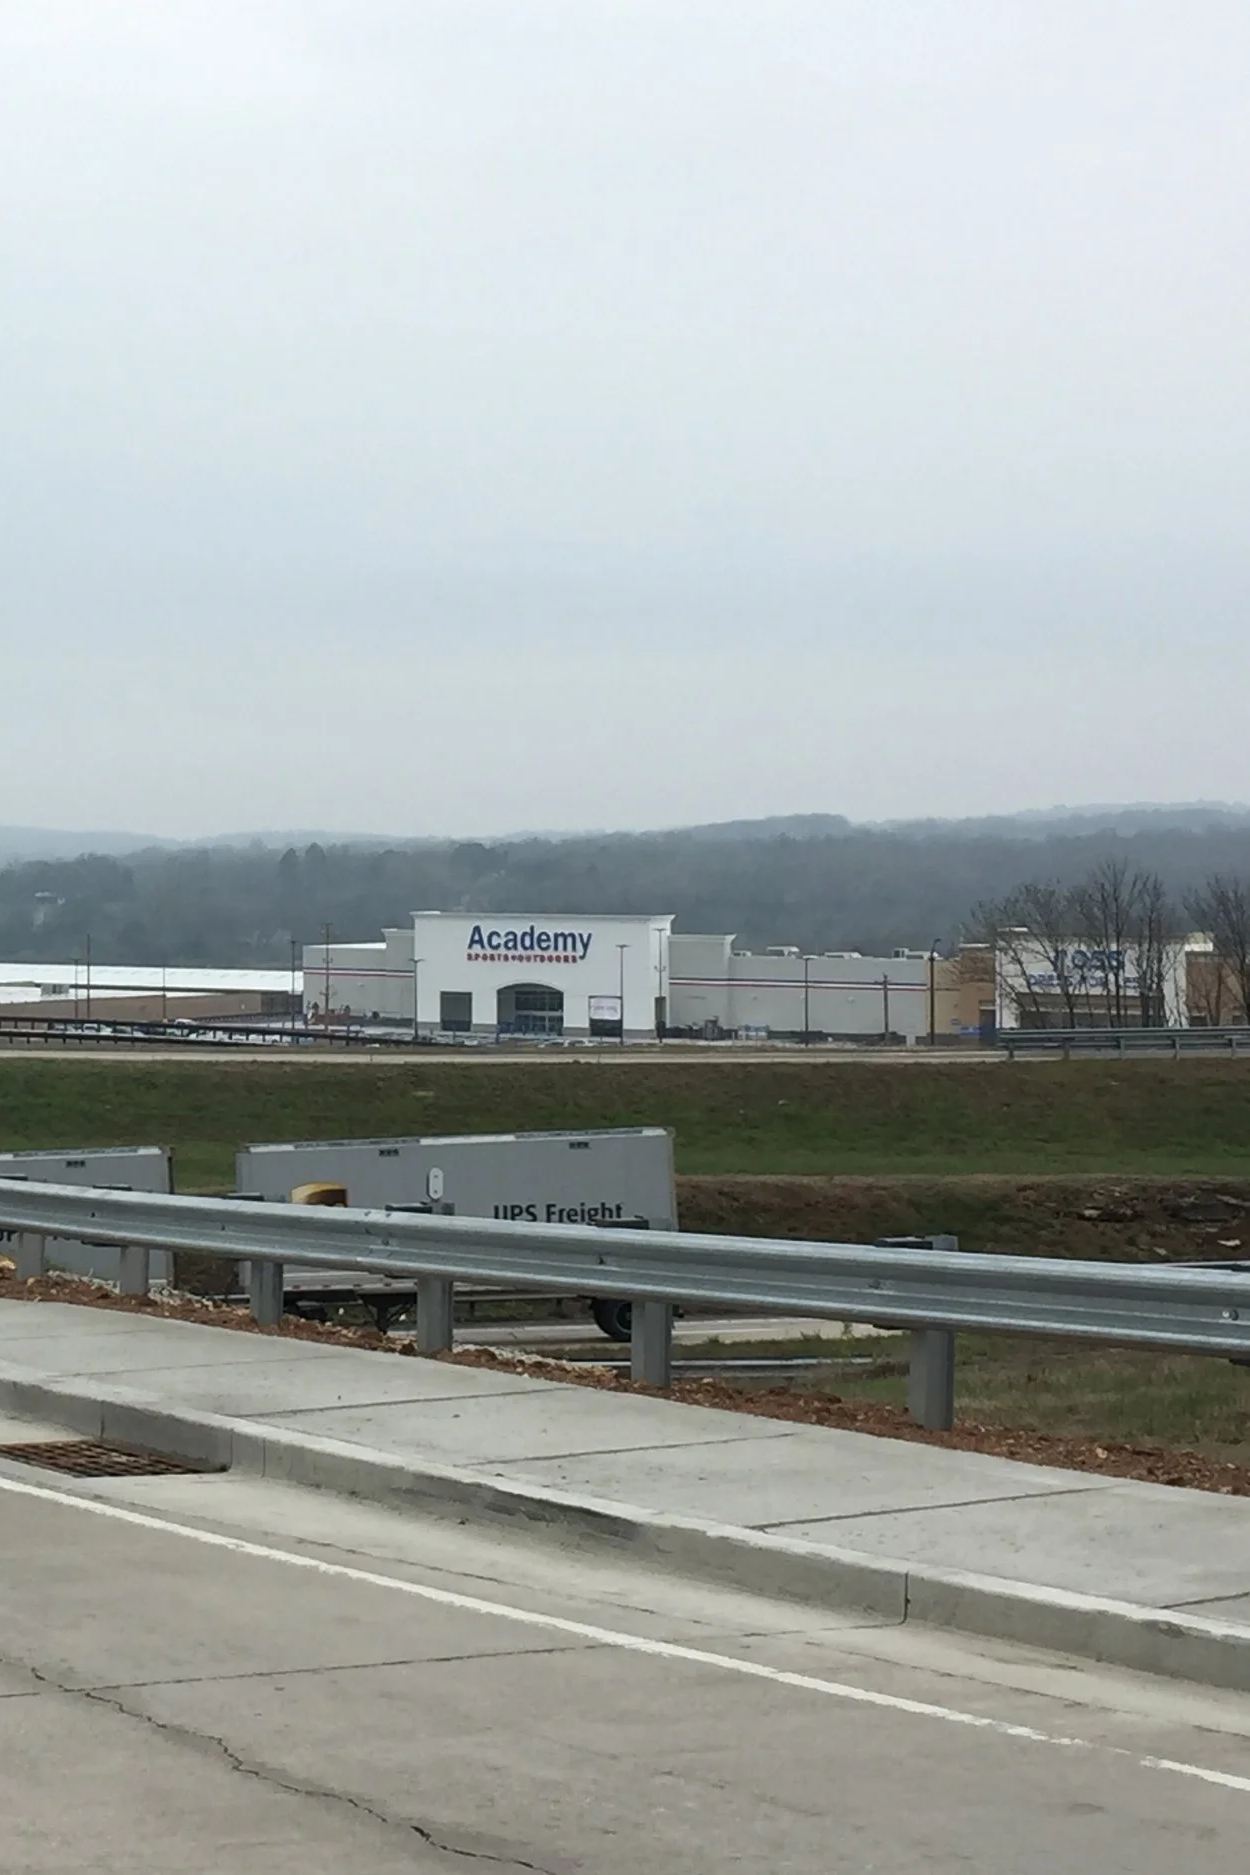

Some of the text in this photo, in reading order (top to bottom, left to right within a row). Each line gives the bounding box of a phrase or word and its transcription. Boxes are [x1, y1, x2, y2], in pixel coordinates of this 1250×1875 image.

[467, 924, 592, 961] Academy
[493, 1202, 624, 1226] UPS Freight
